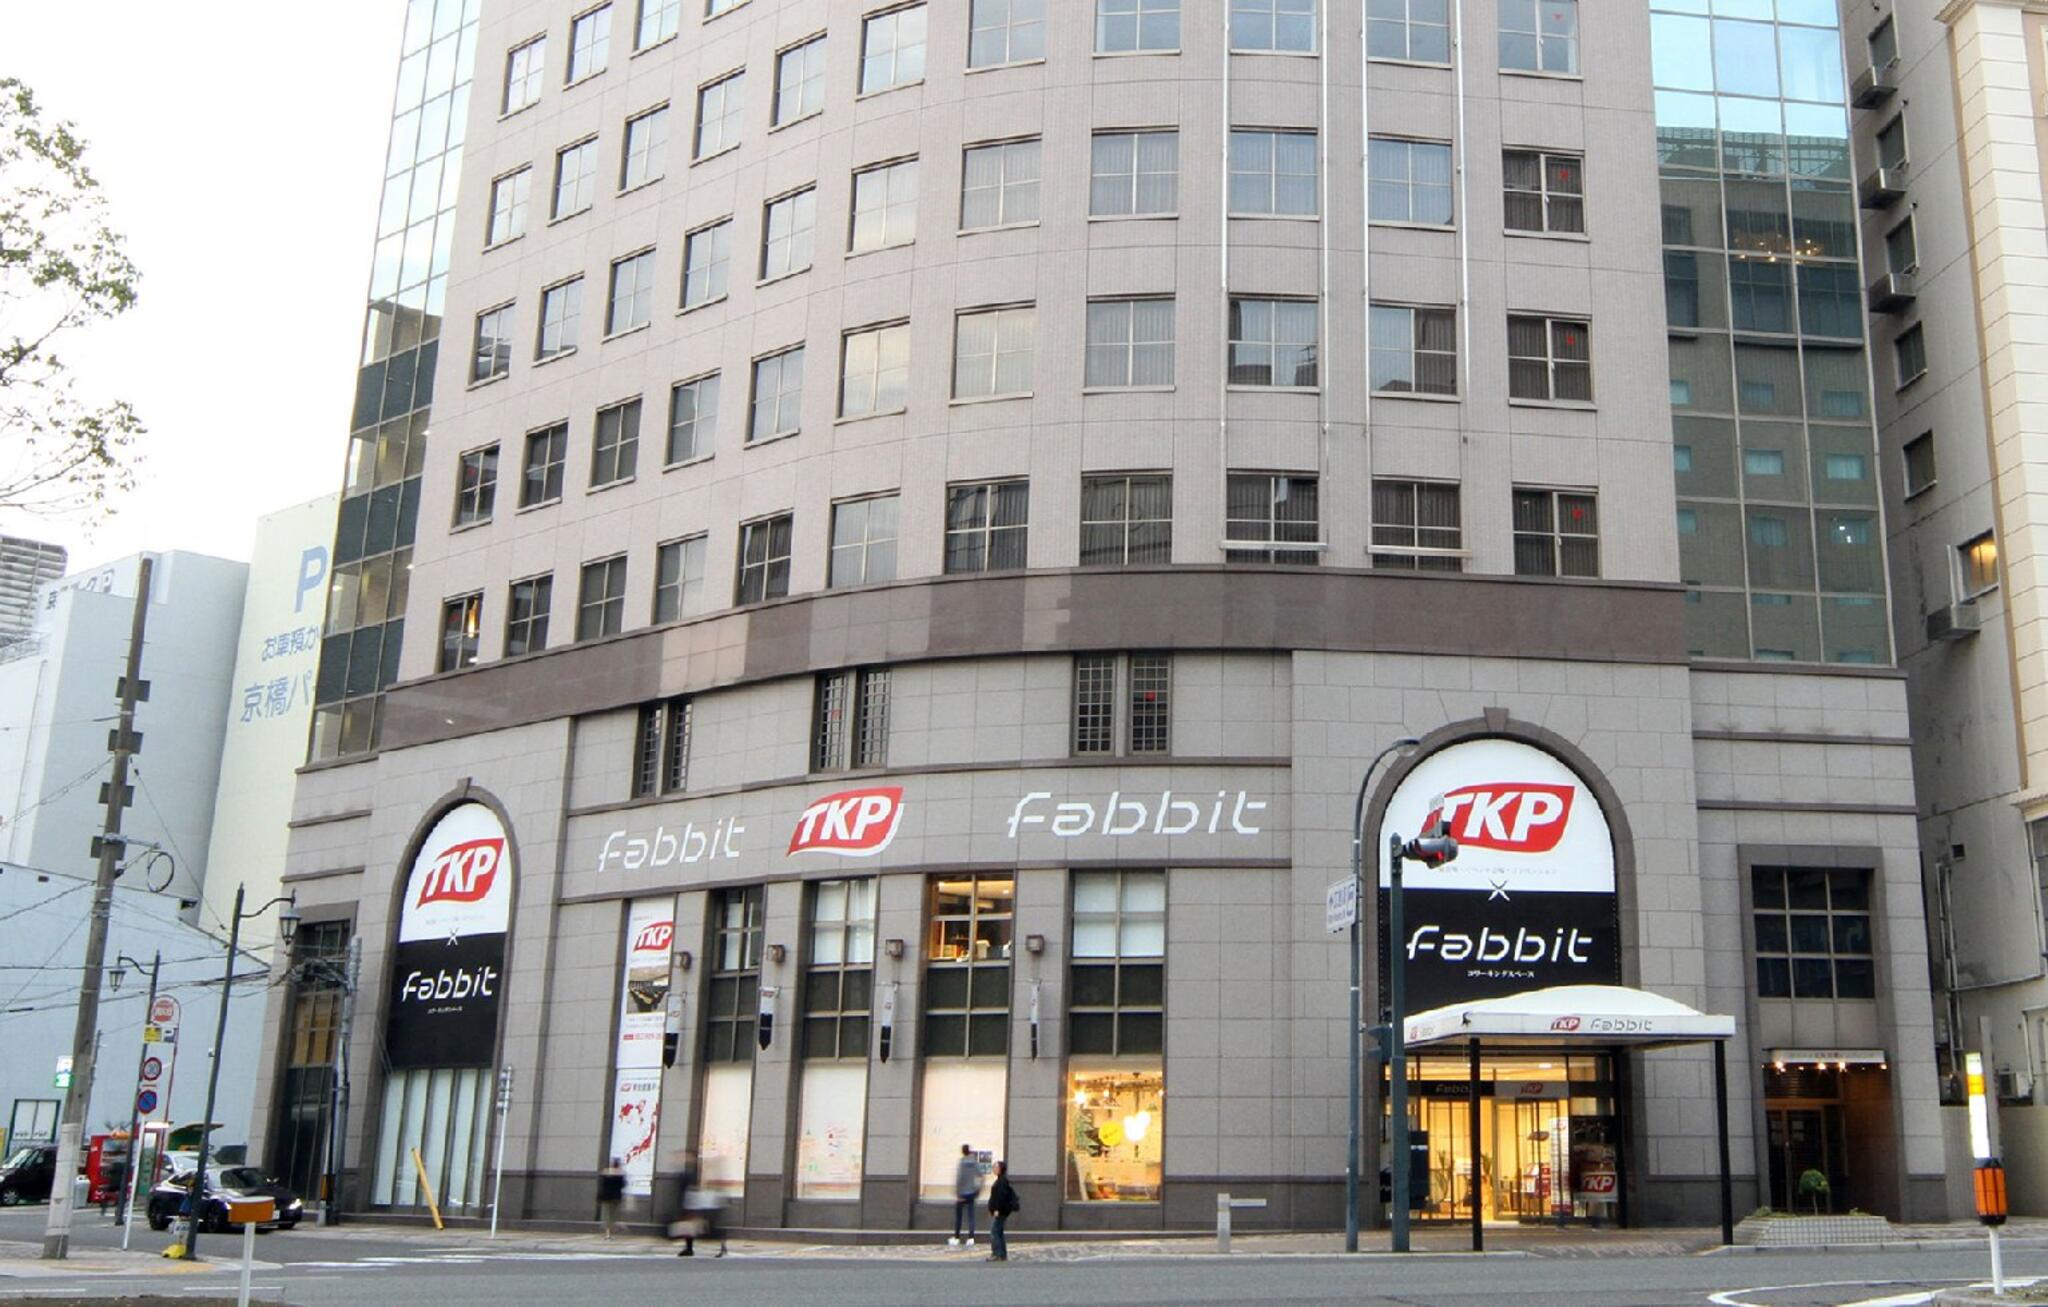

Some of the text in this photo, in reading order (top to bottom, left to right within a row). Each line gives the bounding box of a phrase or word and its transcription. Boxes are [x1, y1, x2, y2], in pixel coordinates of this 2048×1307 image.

[295, 545, 328, 614] P
[796, 793, 895, 848] TKP
[1438, 788, 1566, 844] TKP
[423, 843, 500, 901] TKP
[636, 924, 673, 949] TKP
[1552, 1017, 1578, 1031] TKP
